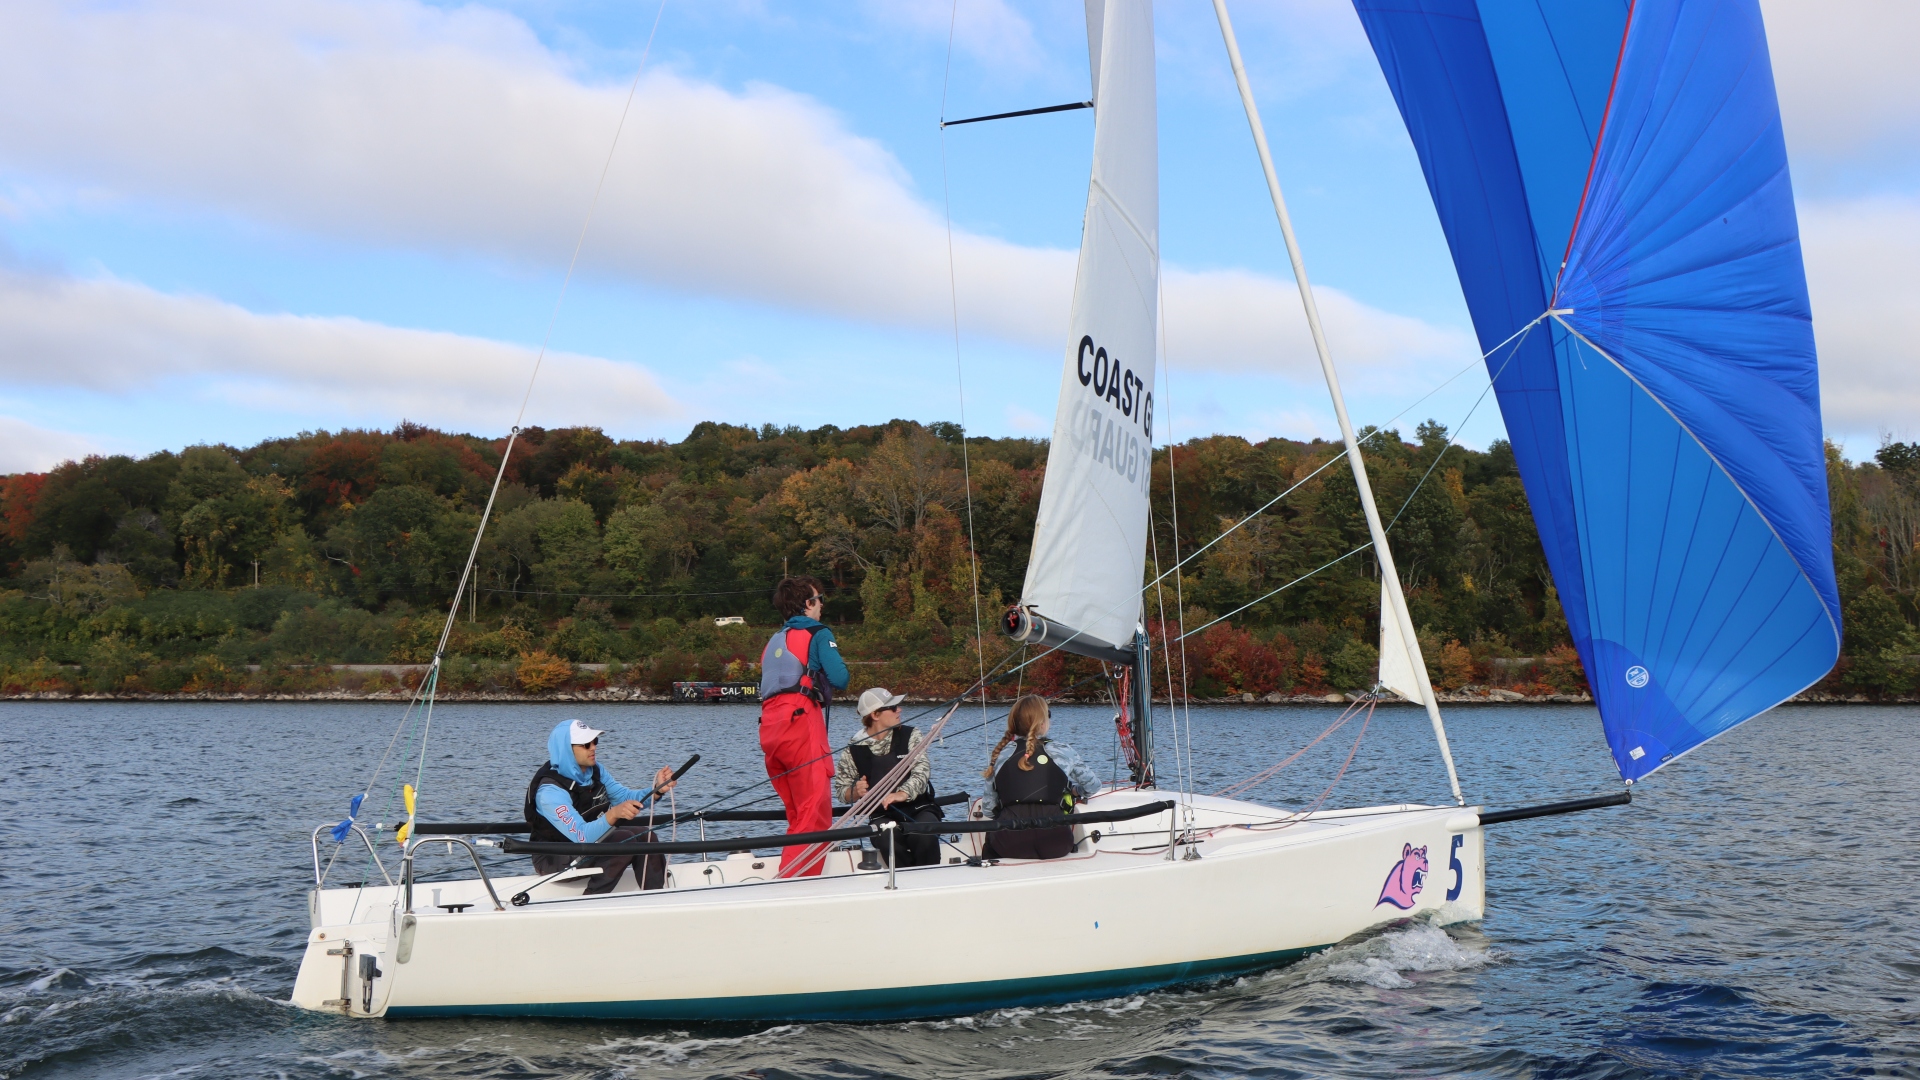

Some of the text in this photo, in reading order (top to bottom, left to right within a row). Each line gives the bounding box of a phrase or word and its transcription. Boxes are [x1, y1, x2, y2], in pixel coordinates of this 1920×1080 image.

[1077, 335, 1143, 424] COAST
[721, 687, 740, 696] CAL
[741, 686, 756, 696] 781
[1446, 834, 1463, 902] 5
